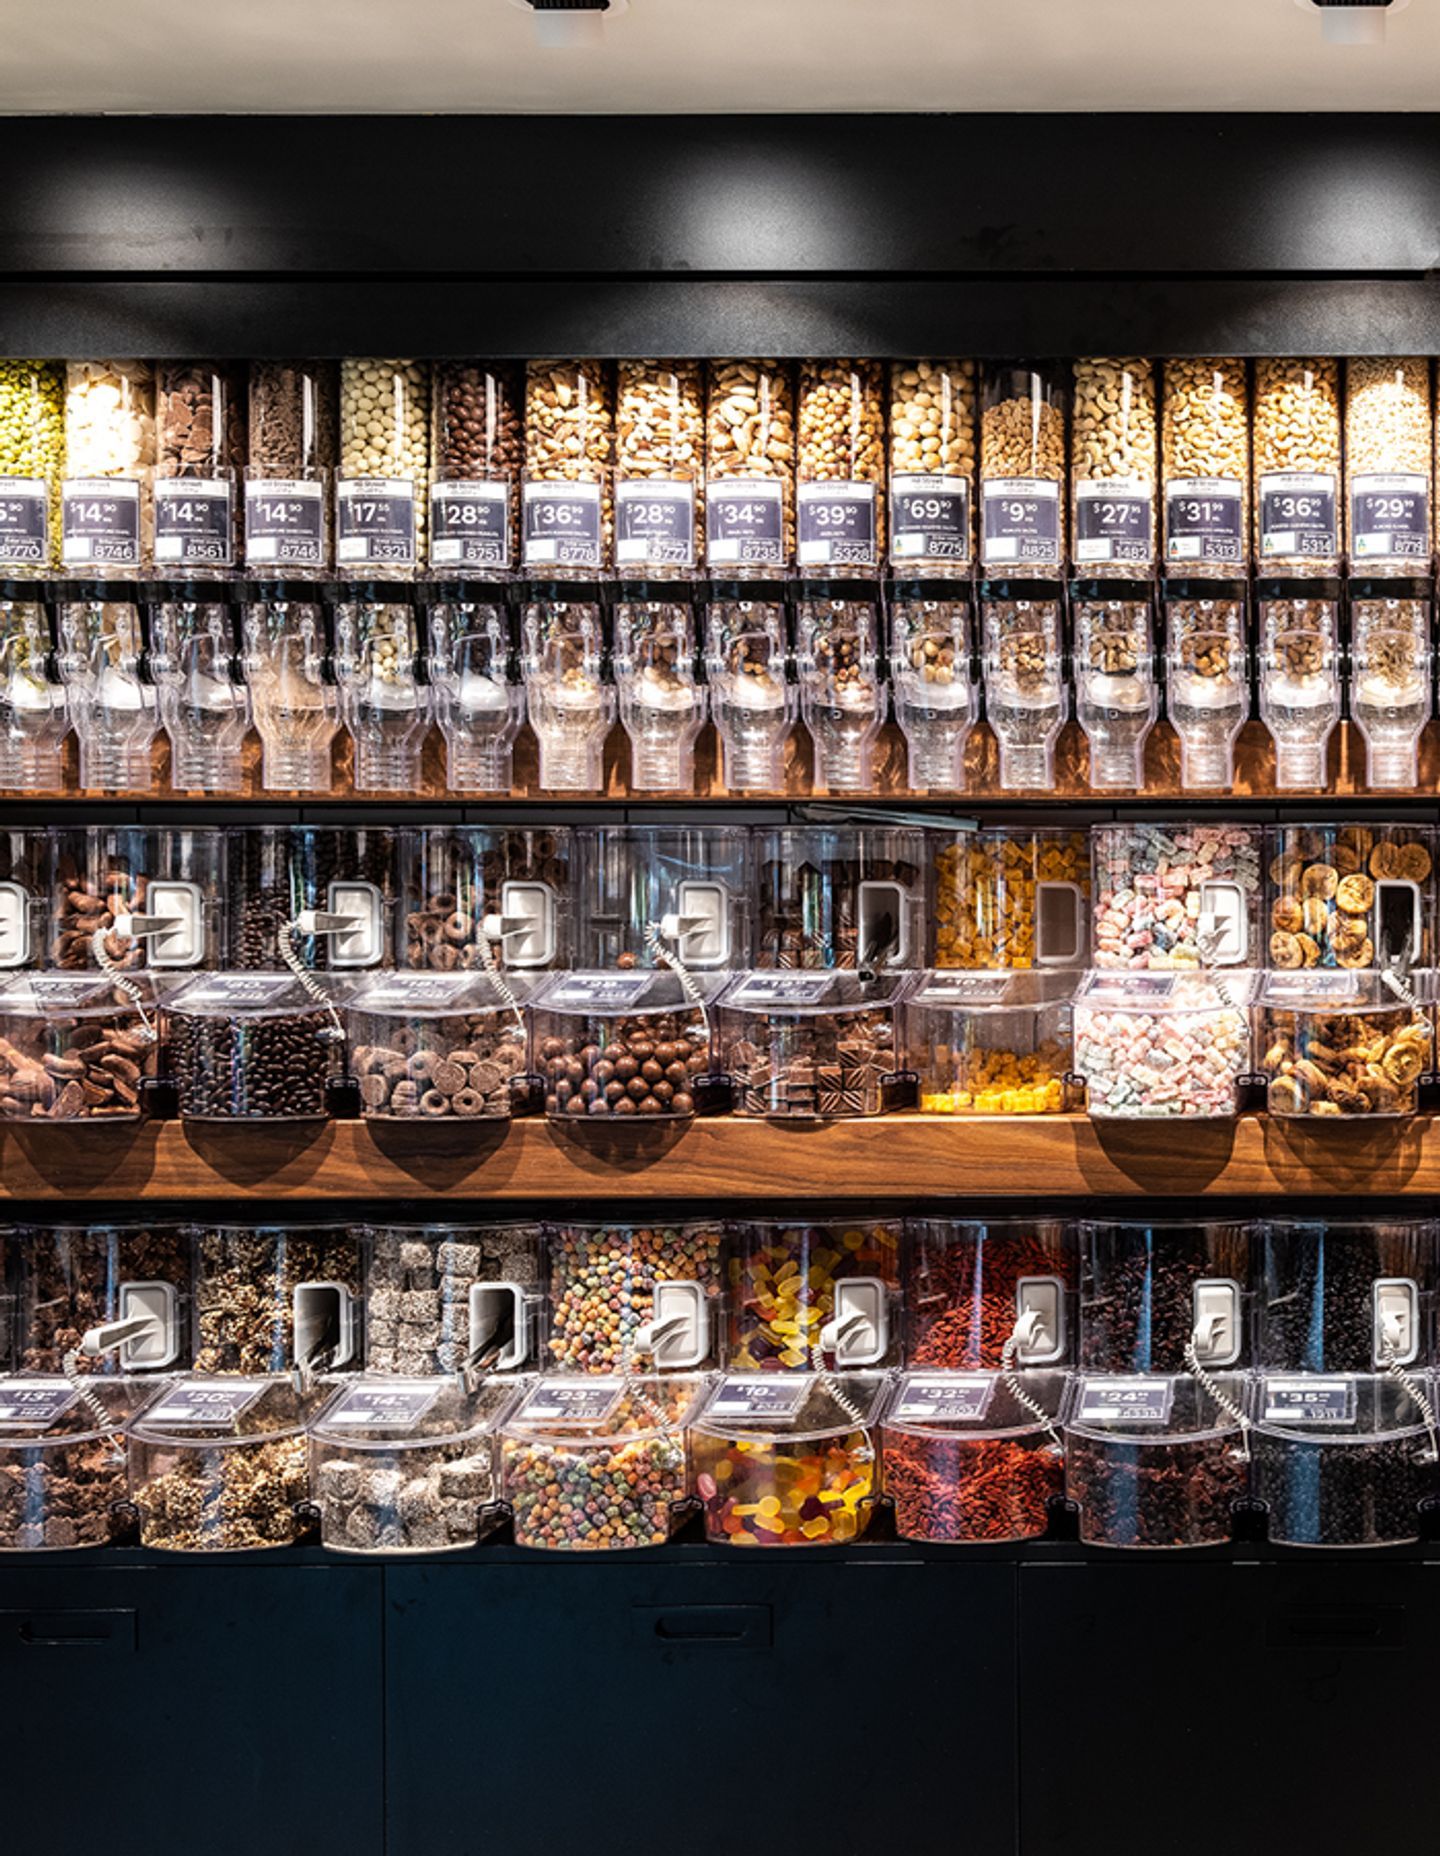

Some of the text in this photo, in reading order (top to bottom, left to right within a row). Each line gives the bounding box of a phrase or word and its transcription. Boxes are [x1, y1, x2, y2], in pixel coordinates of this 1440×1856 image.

[94, 546, 132, 559] 8746
[187, 545, 224, 559] 8561
[280, 546, 317, 559] 8746
[928, 542, 962, 556] 8775
